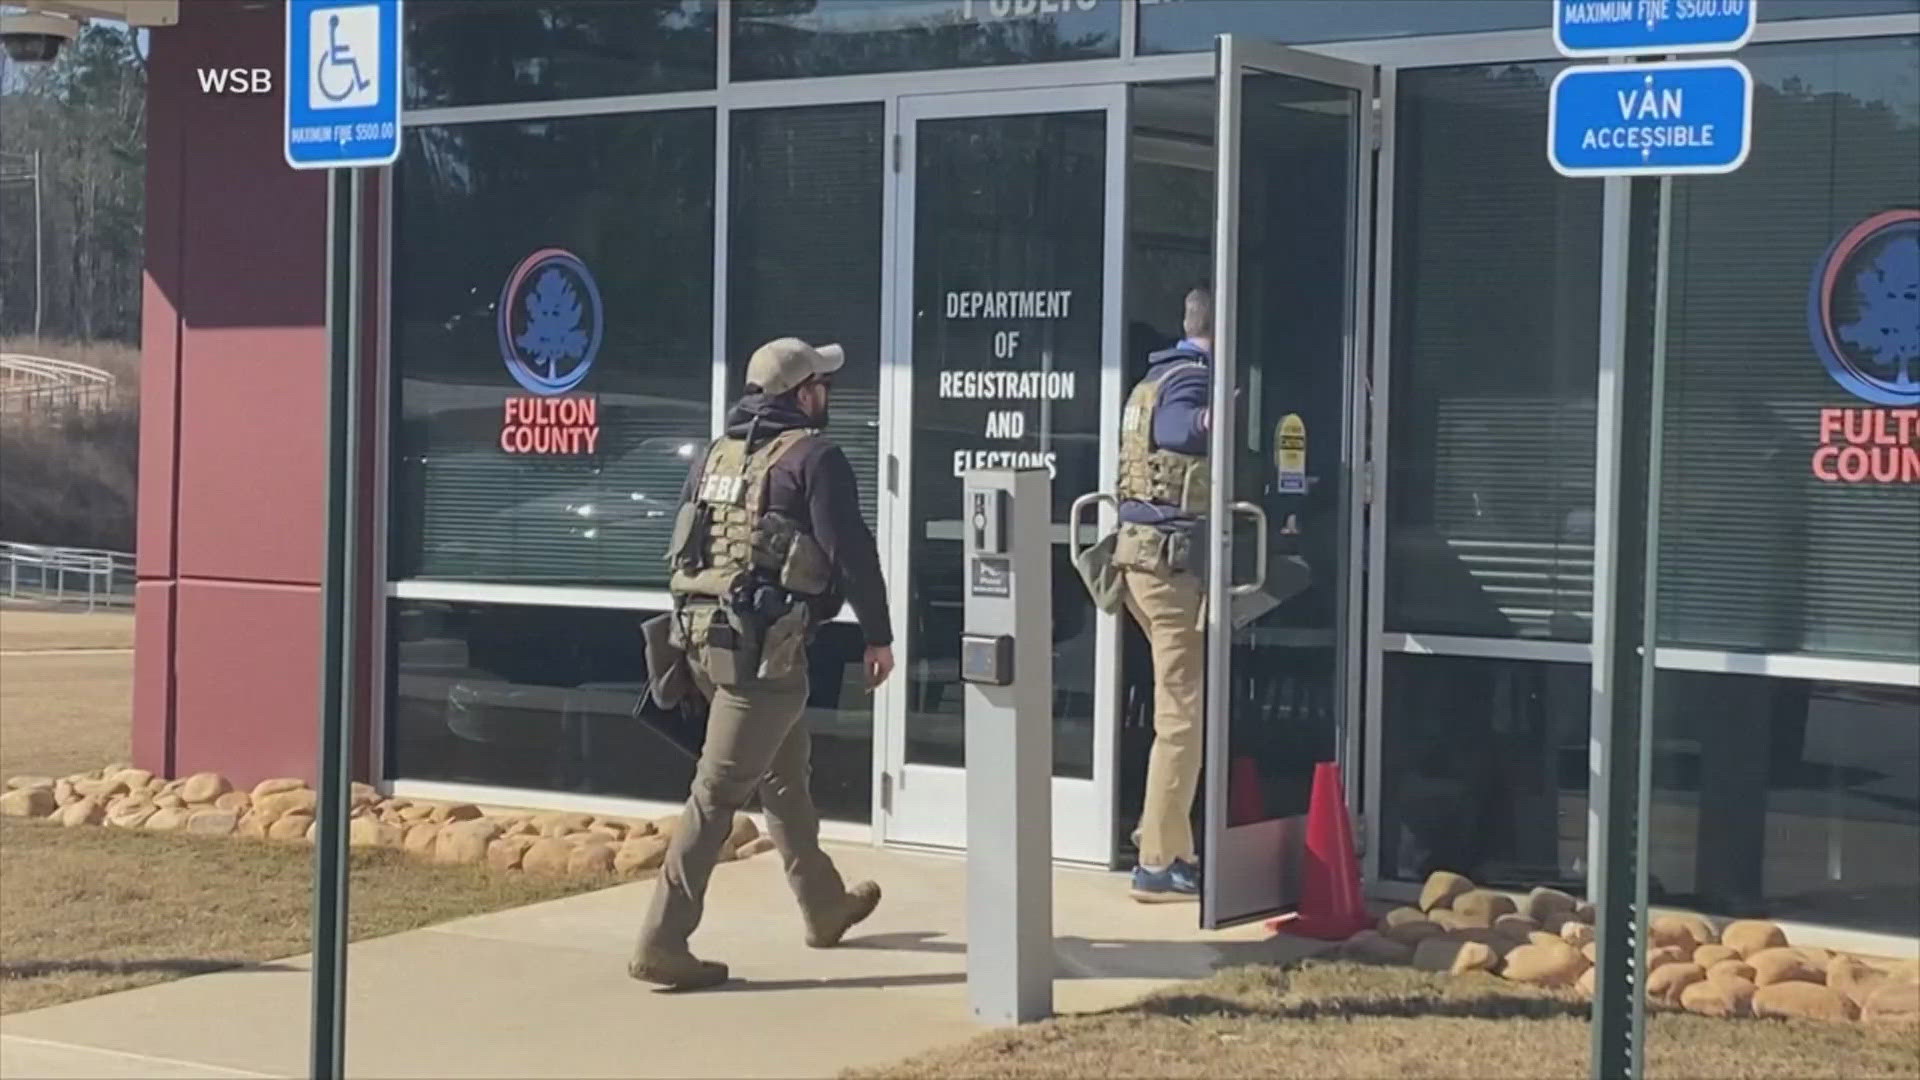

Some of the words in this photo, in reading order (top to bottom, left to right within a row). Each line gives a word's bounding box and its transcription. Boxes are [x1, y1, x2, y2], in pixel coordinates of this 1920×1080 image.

[1565, 4, 1632, 24] MAXIMUM
[1638, 1, 1669, 20] FINE
[1618, 88, 1683, 120] VAN
[1582, 125, 1714, 149] ACCESSIBLE
[946, 291, 1072, 318] DEPARTMENT
[994, 331, 1020, 358] OF
[939, 371, 1075, 399] REGISTRATION
[505, 398, 596, 425] FULTON
[985, 411, 1024, 438] AND
[1820, 408, 1920, 444] FULT
[501, 426, 599, 454] COUNTY
[702, 474, 743, 504] FBI
